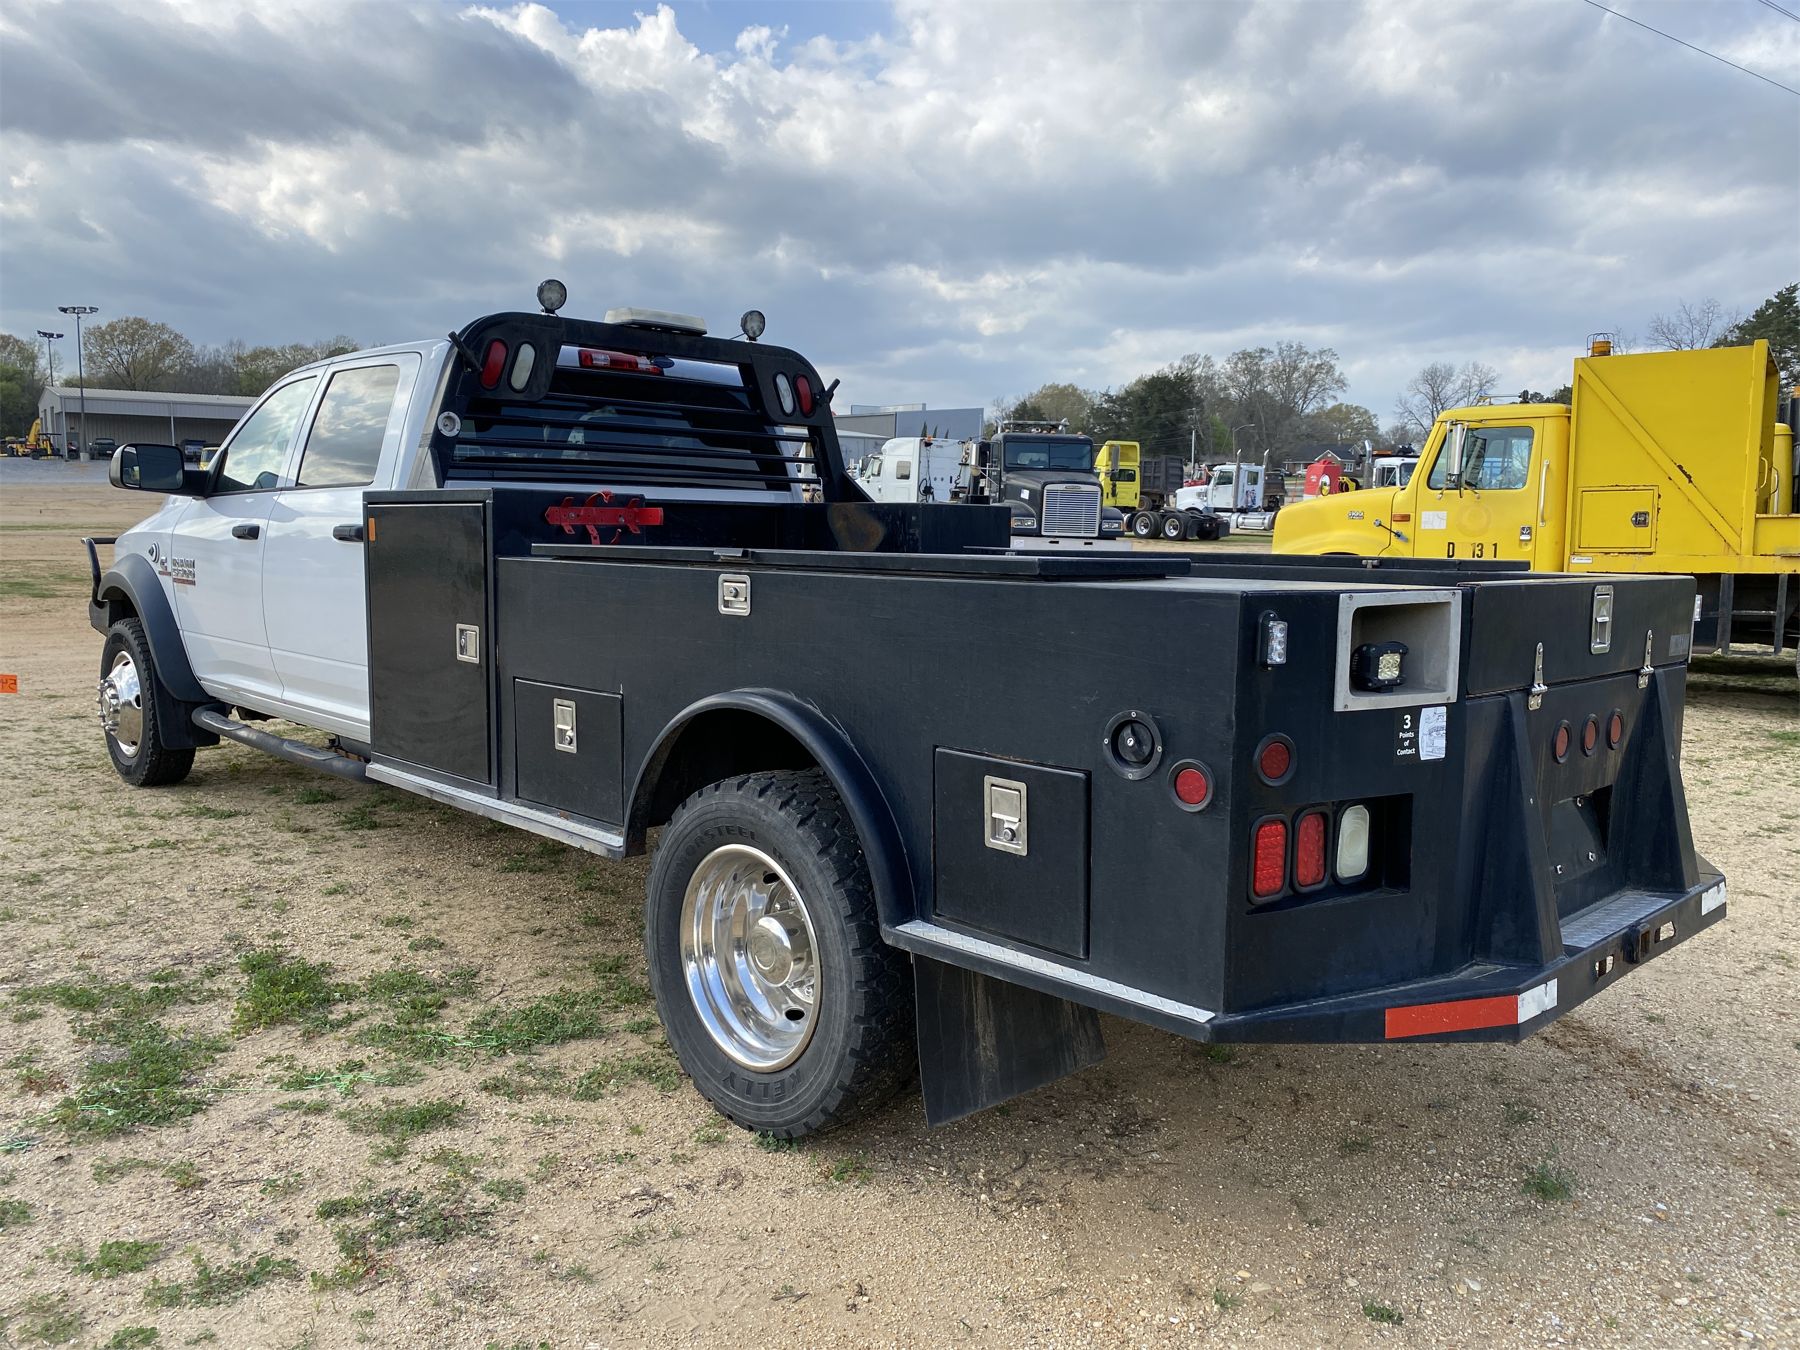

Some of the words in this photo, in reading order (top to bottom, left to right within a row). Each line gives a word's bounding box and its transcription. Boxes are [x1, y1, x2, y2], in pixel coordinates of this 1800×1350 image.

[1403, 714, 1411, 729] 3
[1399, 731, 1415, 739] Points
[1403, 739, 1410, 747] of
[1396, 747, 1416, 756] Contact
[721, 1067, 801, 1099] KELLY
